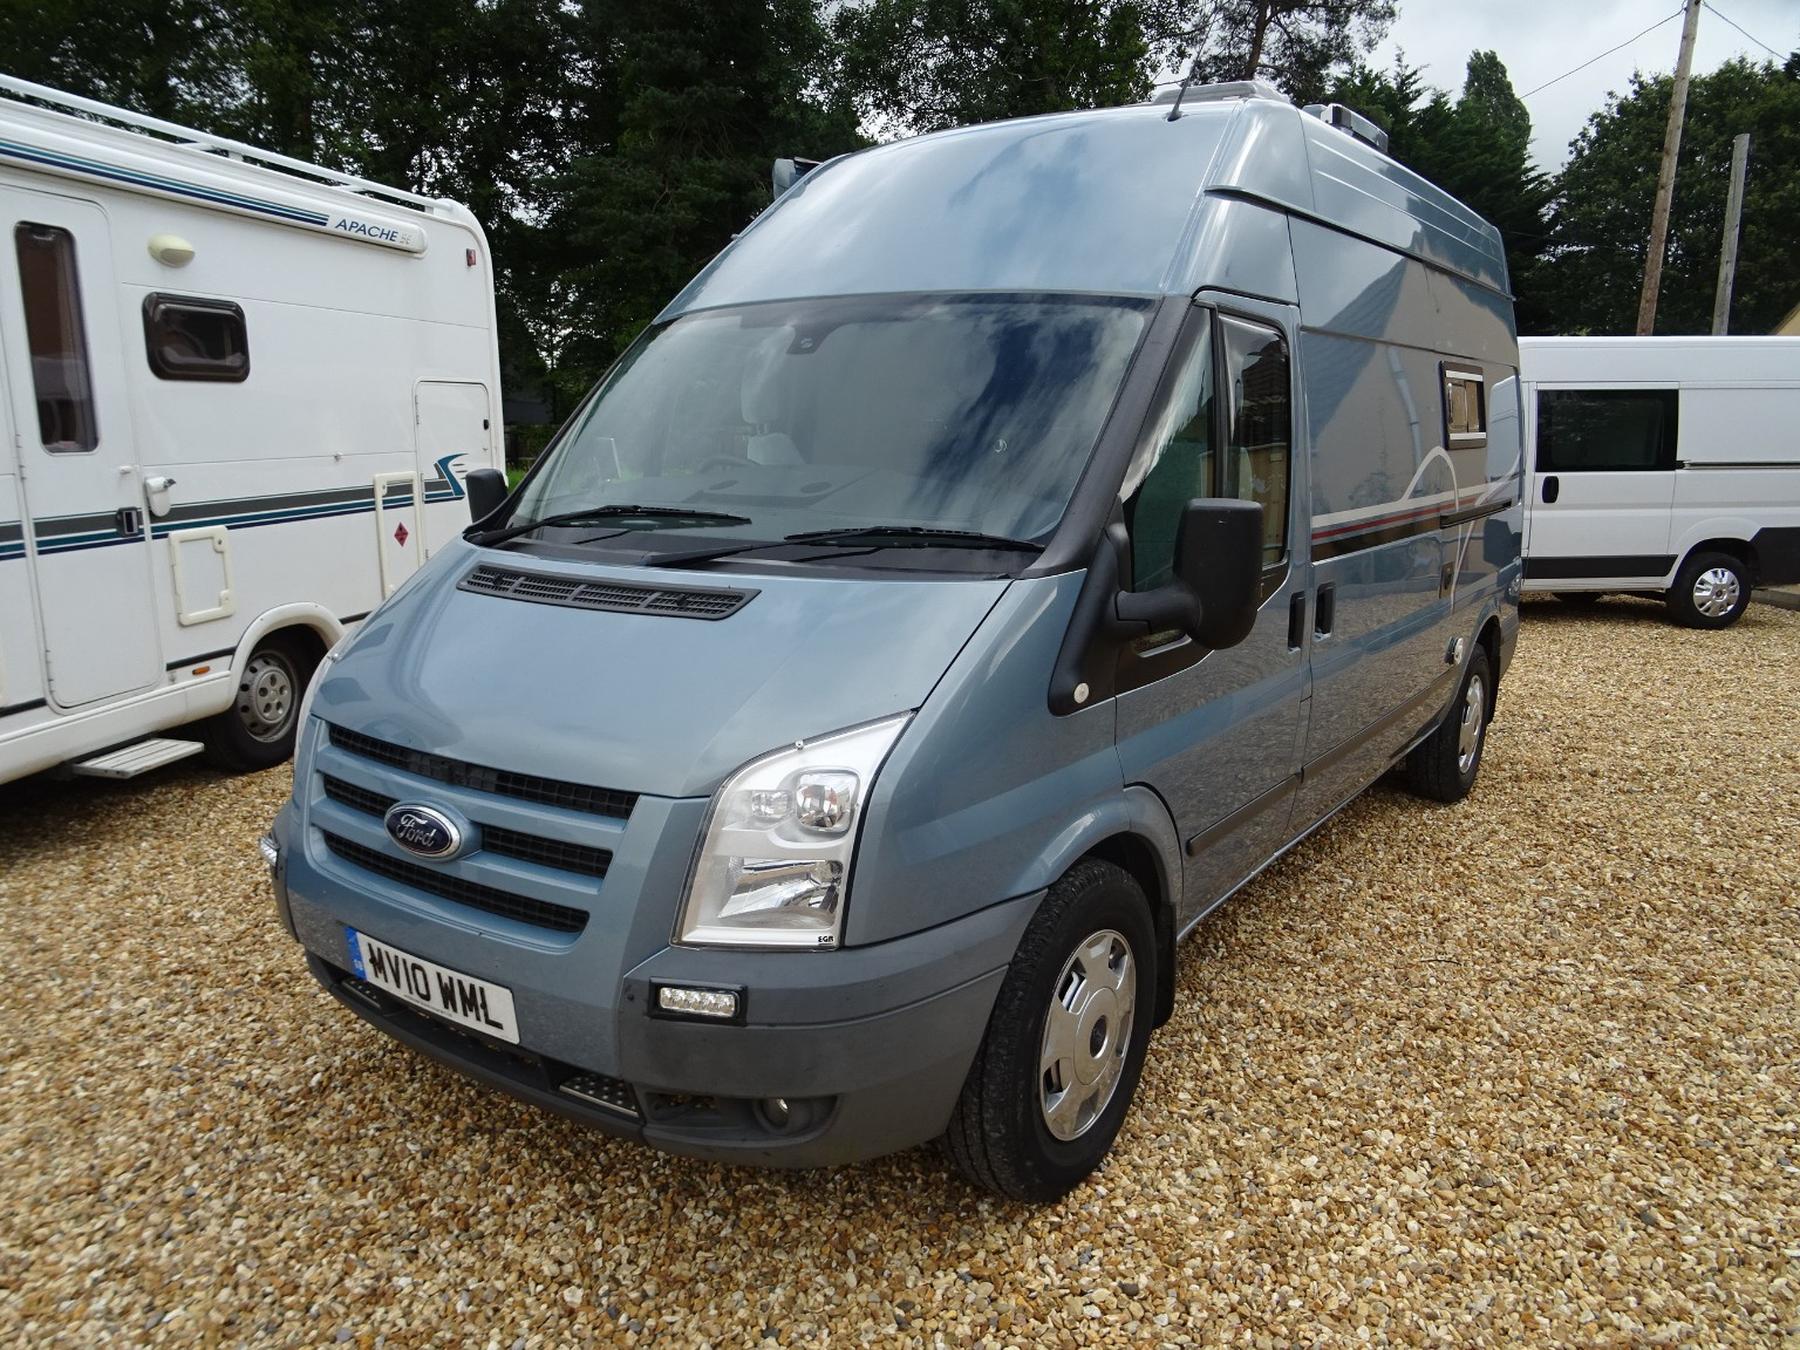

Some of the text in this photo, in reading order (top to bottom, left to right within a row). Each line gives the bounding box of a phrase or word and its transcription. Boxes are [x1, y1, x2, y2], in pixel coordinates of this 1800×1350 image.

[335, 219, 398, 242] APACHE
[396, 813, 437, 847] Ford
[367, 942, 431, 1001] MV10
[436, 971, 504, 1030] WML
